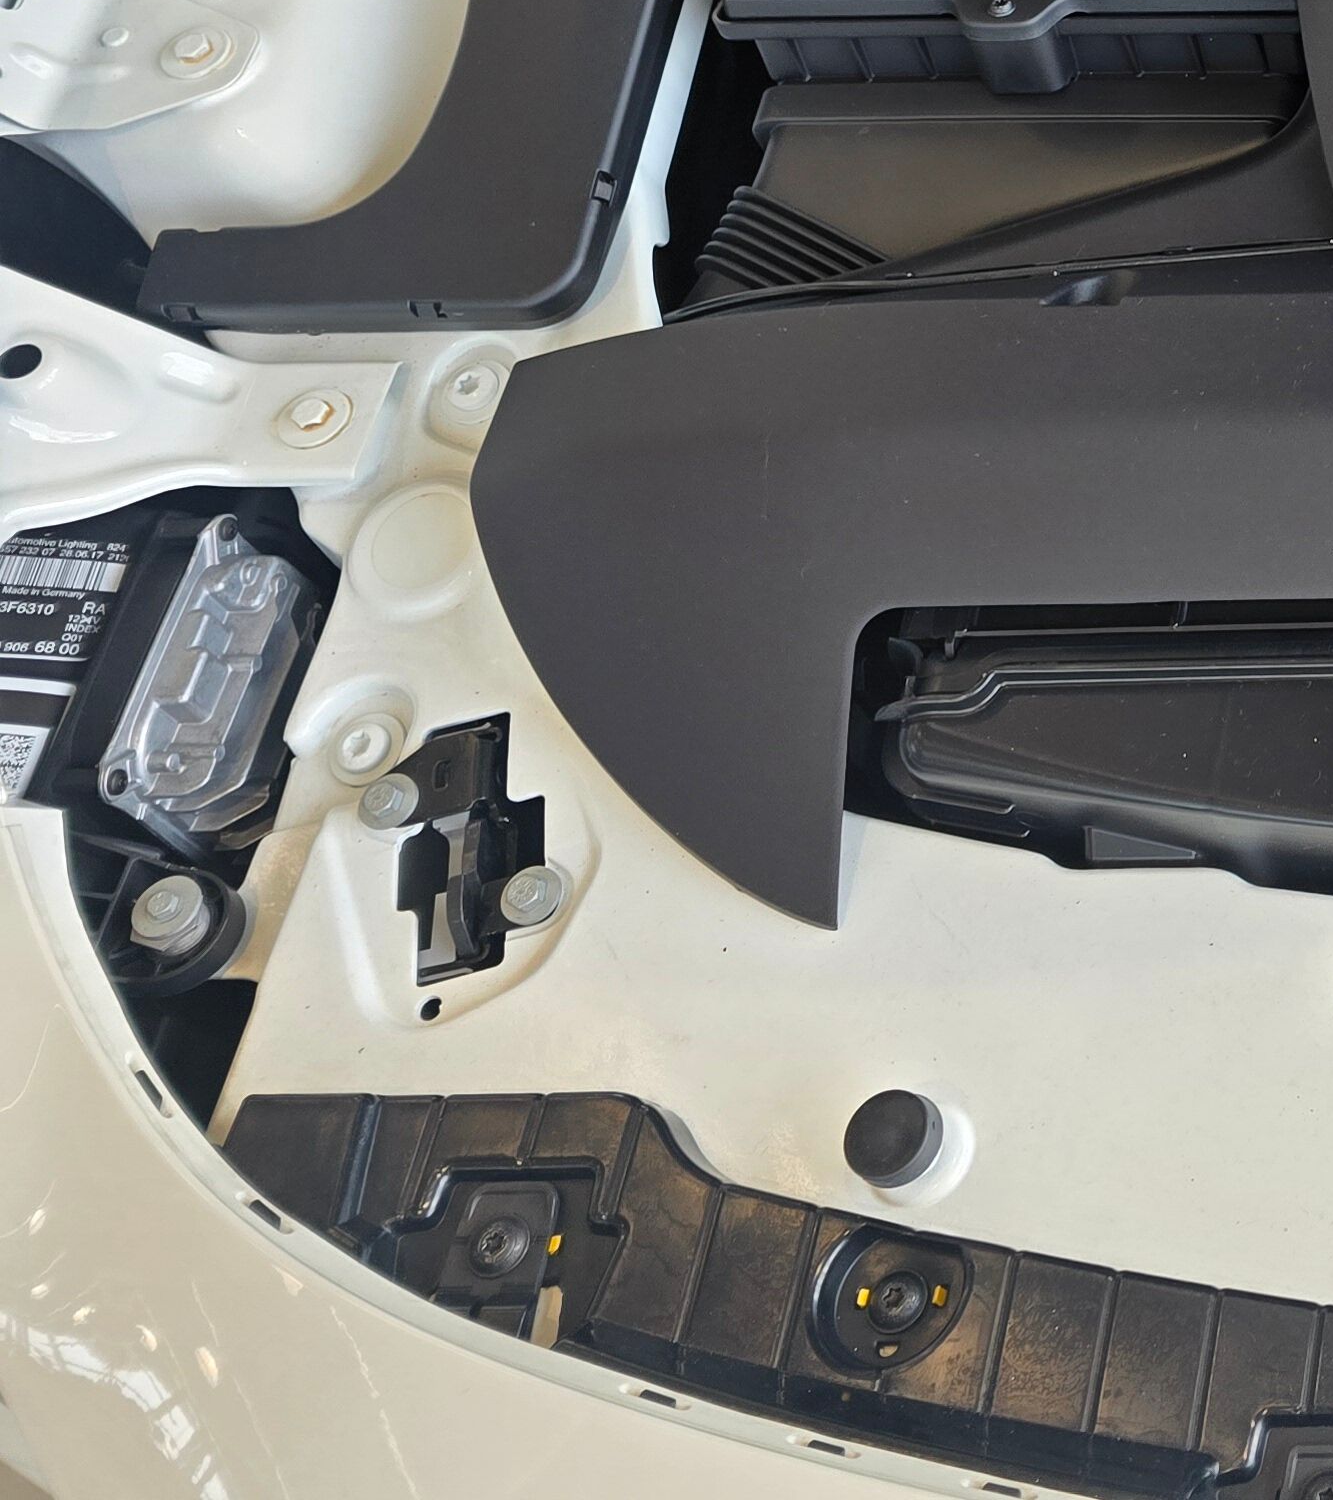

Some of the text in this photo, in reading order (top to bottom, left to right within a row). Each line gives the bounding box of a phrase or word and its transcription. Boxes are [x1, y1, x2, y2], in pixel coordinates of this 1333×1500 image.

[58, 539, 98, 551] Lighting
[2, 585, 85, 601] Made in Germany
[3, 641, 80, 655] 906 68 00
